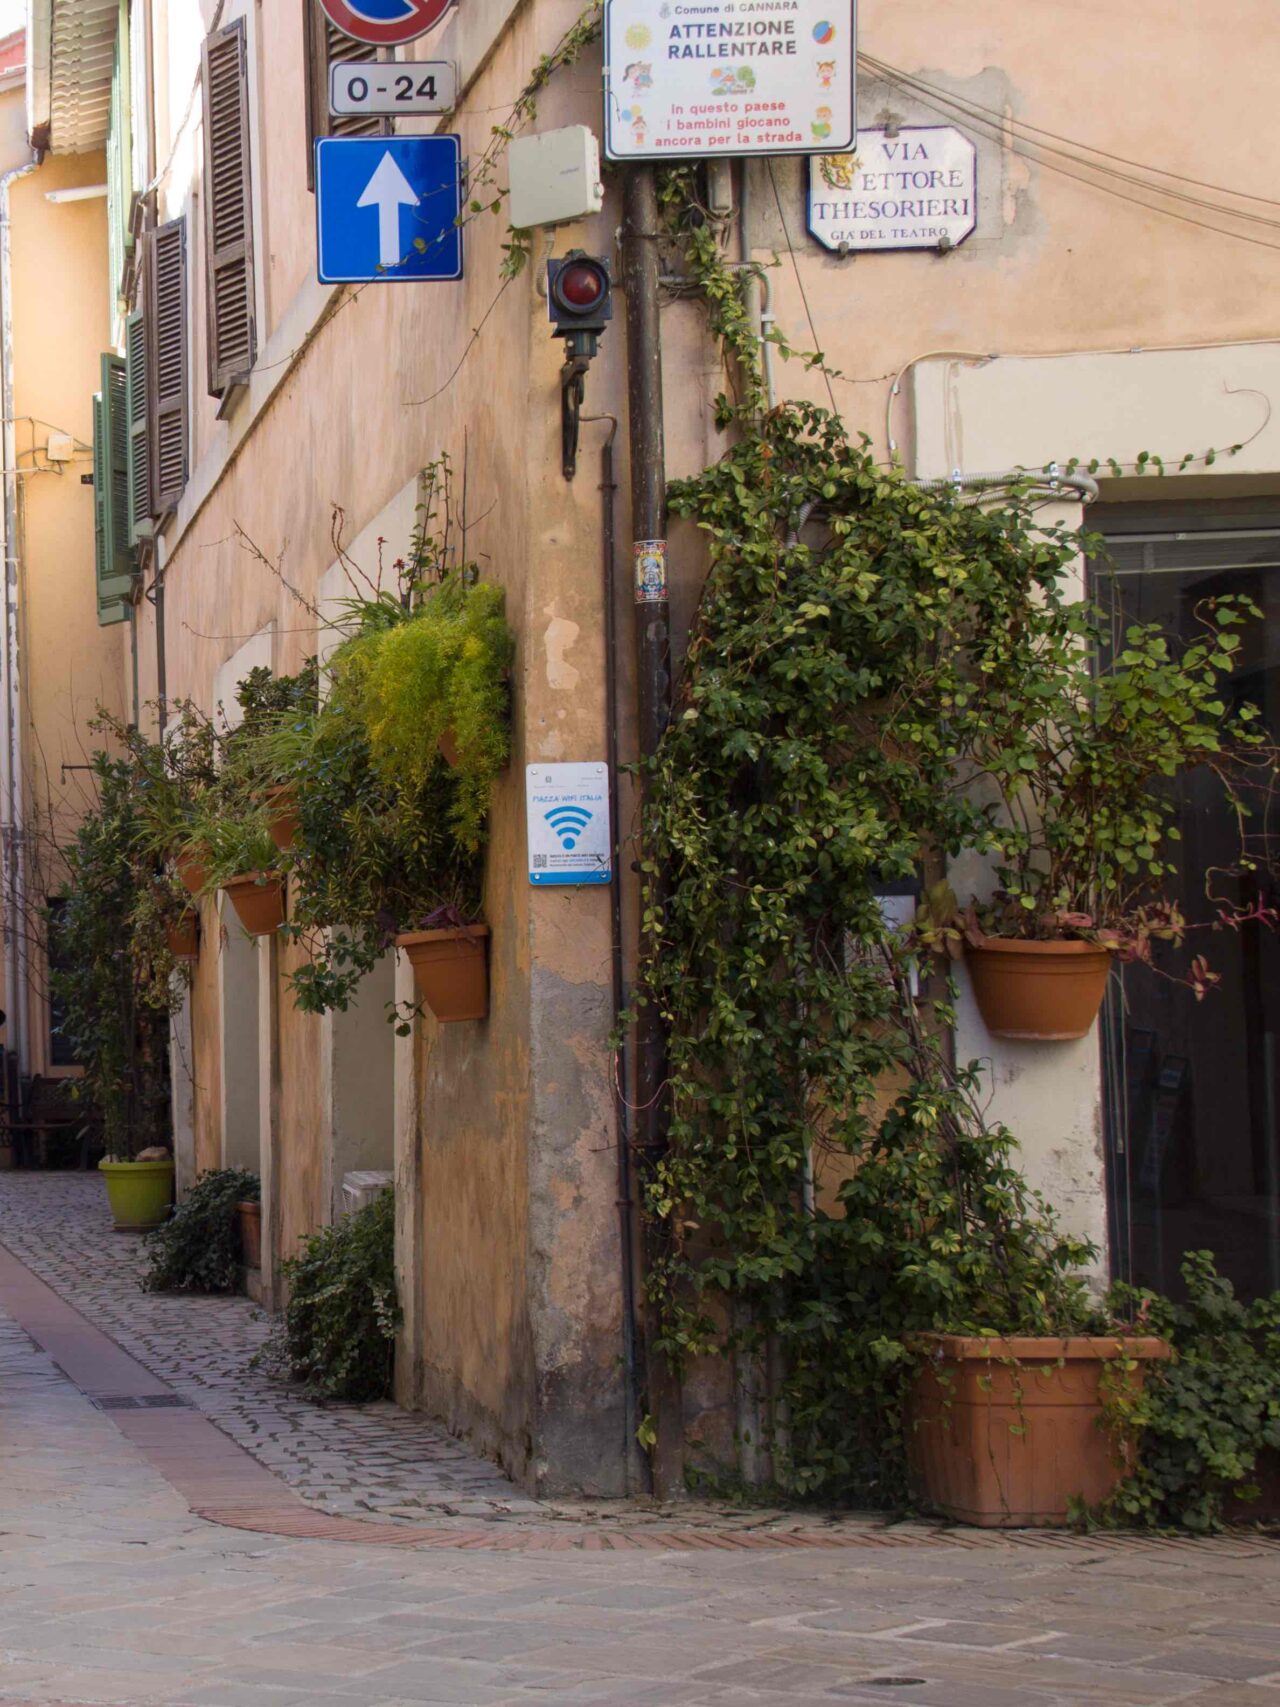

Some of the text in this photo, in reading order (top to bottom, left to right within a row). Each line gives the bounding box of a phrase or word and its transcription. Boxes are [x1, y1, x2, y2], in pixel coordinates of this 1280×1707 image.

[674, 1, 799, 16] Comune di CANNARA
[669, 20, 795, 40] ATTENZIONE
[668, 40, 797, 60] RALLENTARE
[347, 77, 368, 102] 0
[395, 75, 437, 101] 24
[690, 102, 739, 117] questo
[744, 102, 786, 114] paese
[676, 118, 731, 131] bambini
[736, 117, 791, 131] giocano
[655, 131, 803, 147] ancora per la strada
[881, 142, 929, 161] VIA
[862, 170, 965, 192] ETTORE
[813, 198, 970, 220] THESORIERI
[860, 229, 886, 240] DEL
[890, 227, 949, 238] TEATRO
[532, 795, 559, 803] PIAZZA
